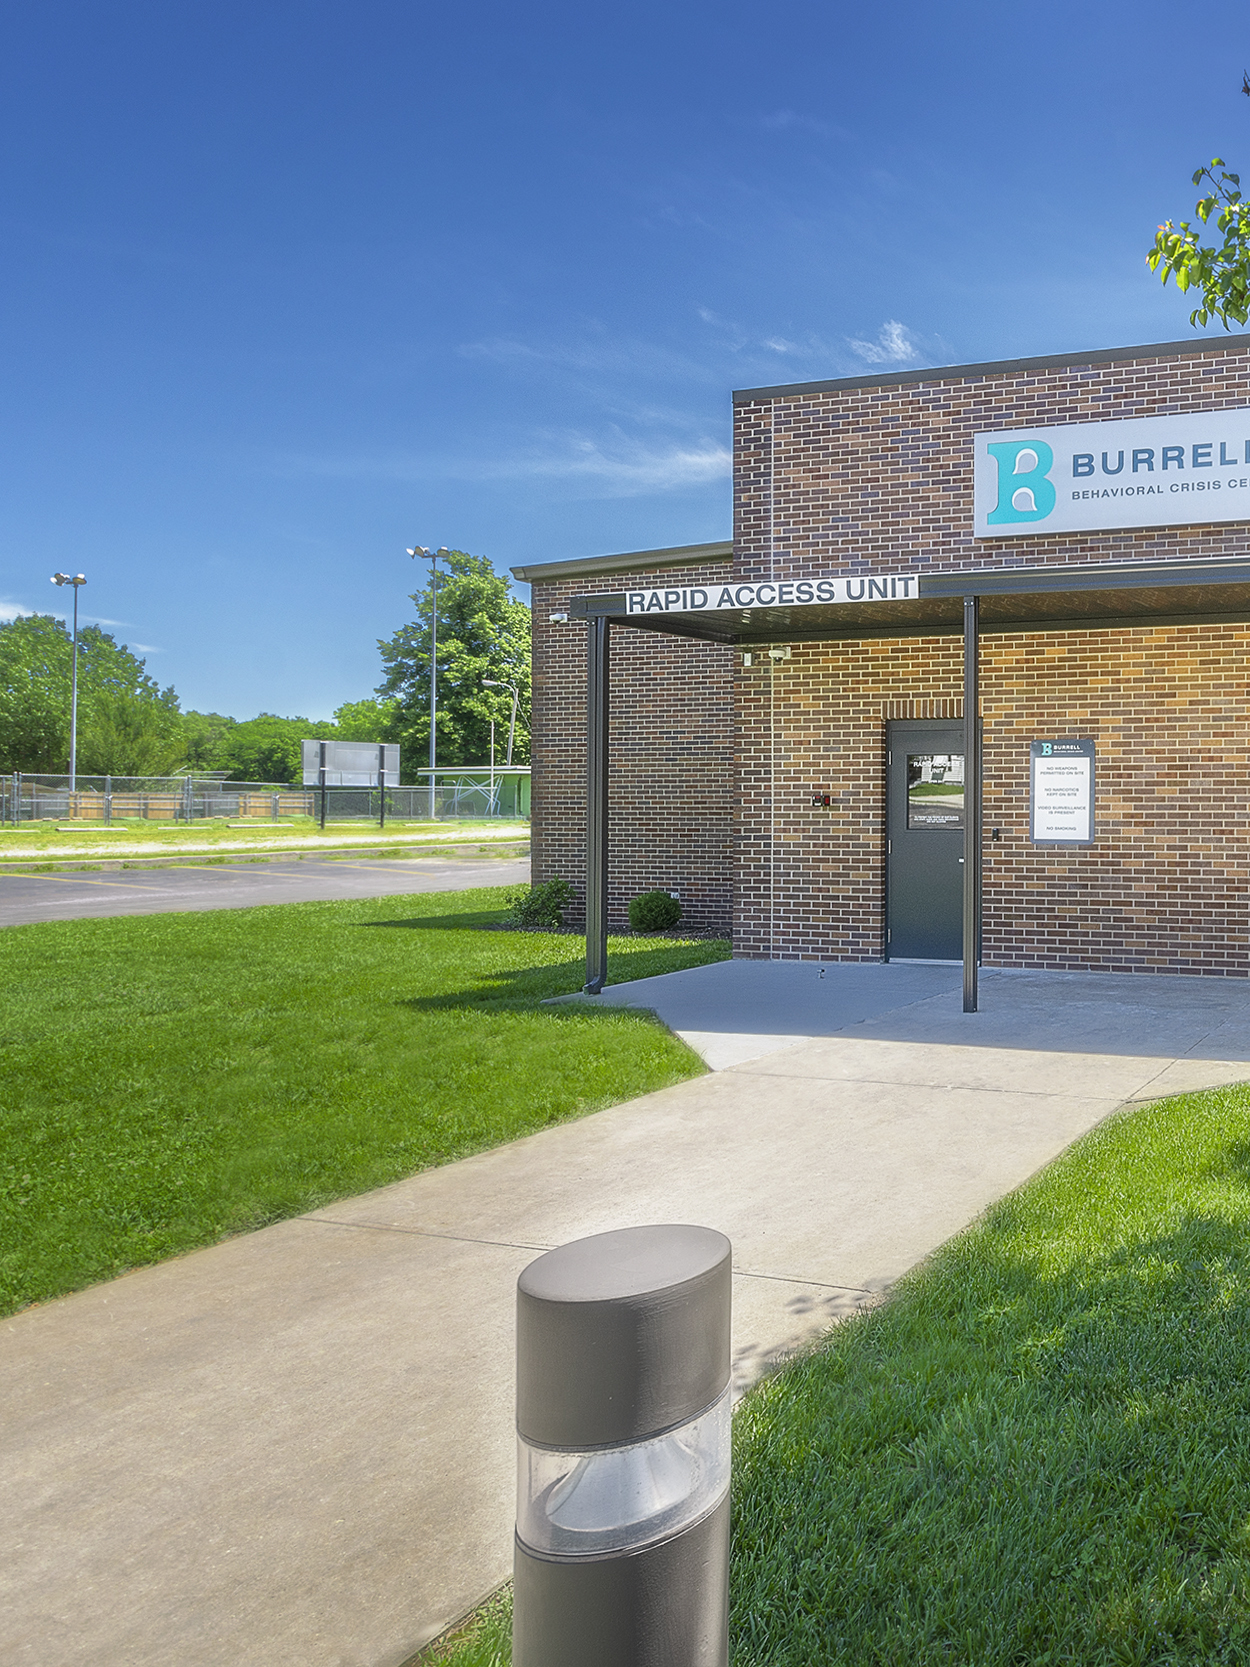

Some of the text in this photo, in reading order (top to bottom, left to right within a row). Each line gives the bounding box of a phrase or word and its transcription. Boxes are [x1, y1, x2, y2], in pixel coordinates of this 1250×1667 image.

[1071, 484, 1164, 500] BEHAVIORAL
[1170, 480, 1222, 493] CRISIS
[629, 577, 915, 613] RAPID ACCESS UNIT
